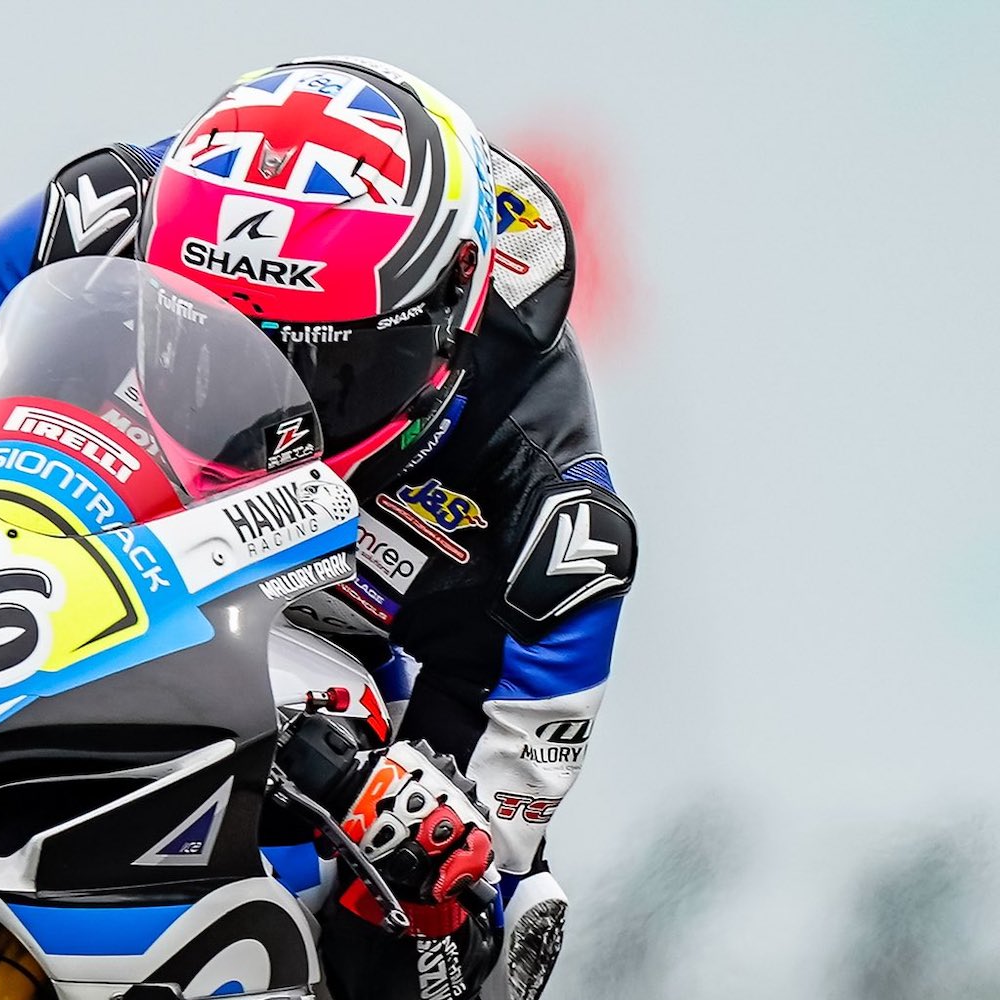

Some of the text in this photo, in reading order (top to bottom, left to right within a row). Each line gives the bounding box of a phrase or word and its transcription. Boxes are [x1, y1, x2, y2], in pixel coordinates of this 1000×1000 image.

[184, 242, 318, 288] SHARK
[3, 405, 141, 484] PIRELLI
[222, 482, 318, 544] HAWK
[247, 518, 319, 558] RACING
[258, 551, 352, 601] MALLORY PARK
[519, 743, 583, 764] MLLORY
